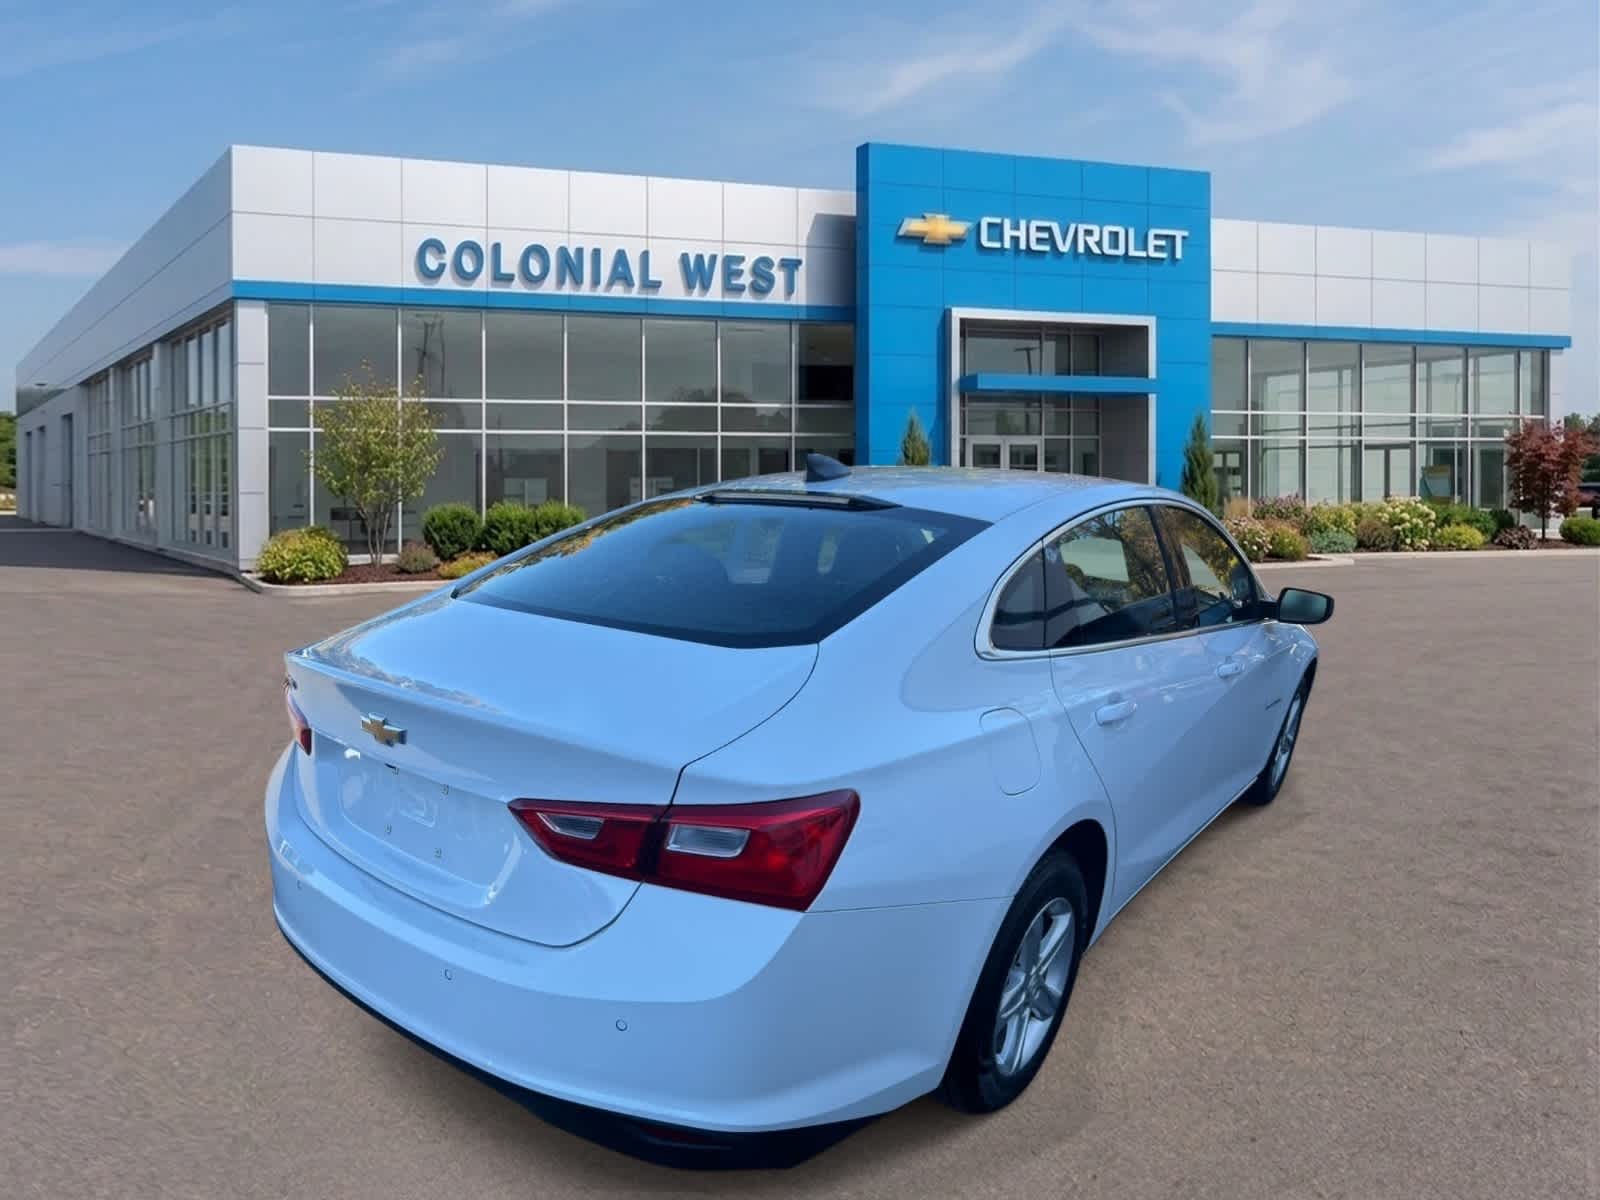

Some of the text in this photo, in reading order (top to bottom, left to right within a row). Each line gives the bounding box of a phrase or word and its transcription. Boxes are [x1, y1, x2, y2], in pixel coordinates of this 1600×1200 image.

[980, 216, 1189, 260] CHEVROLET
[416, 238, 803, 298] COLONIAL WEST
